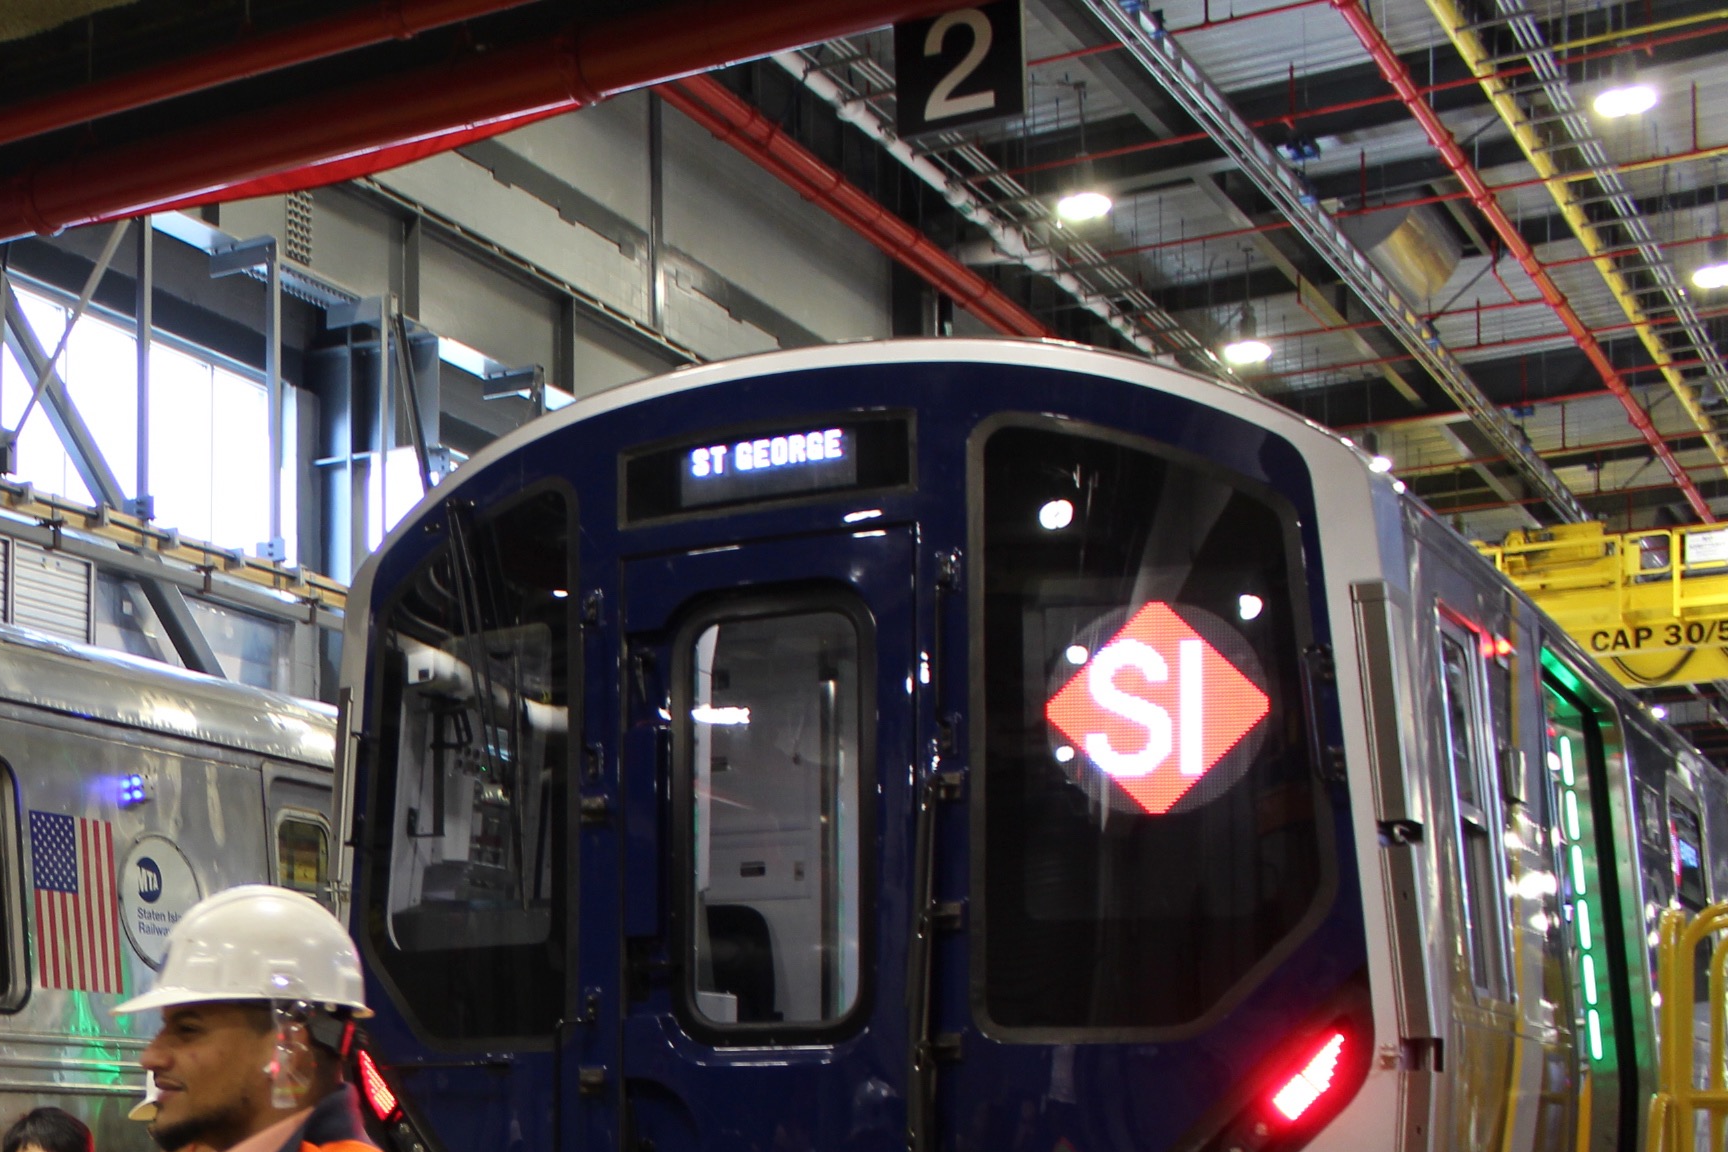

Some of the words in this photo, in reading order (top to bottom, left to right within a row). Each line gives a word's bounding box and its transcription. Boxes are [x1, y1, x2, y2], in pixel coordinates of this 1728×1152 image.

[924, 8, 995, 122] 2
[691, 444, 727, 477] ST
[734, 428, 843, 471] GEORGE
[1591, 626, 1653, 652] CAP
[1085, 638, 1203, 777] SI
[137, 906, 165, 922] Staten
[138, 921, 170, 937] Railwa
